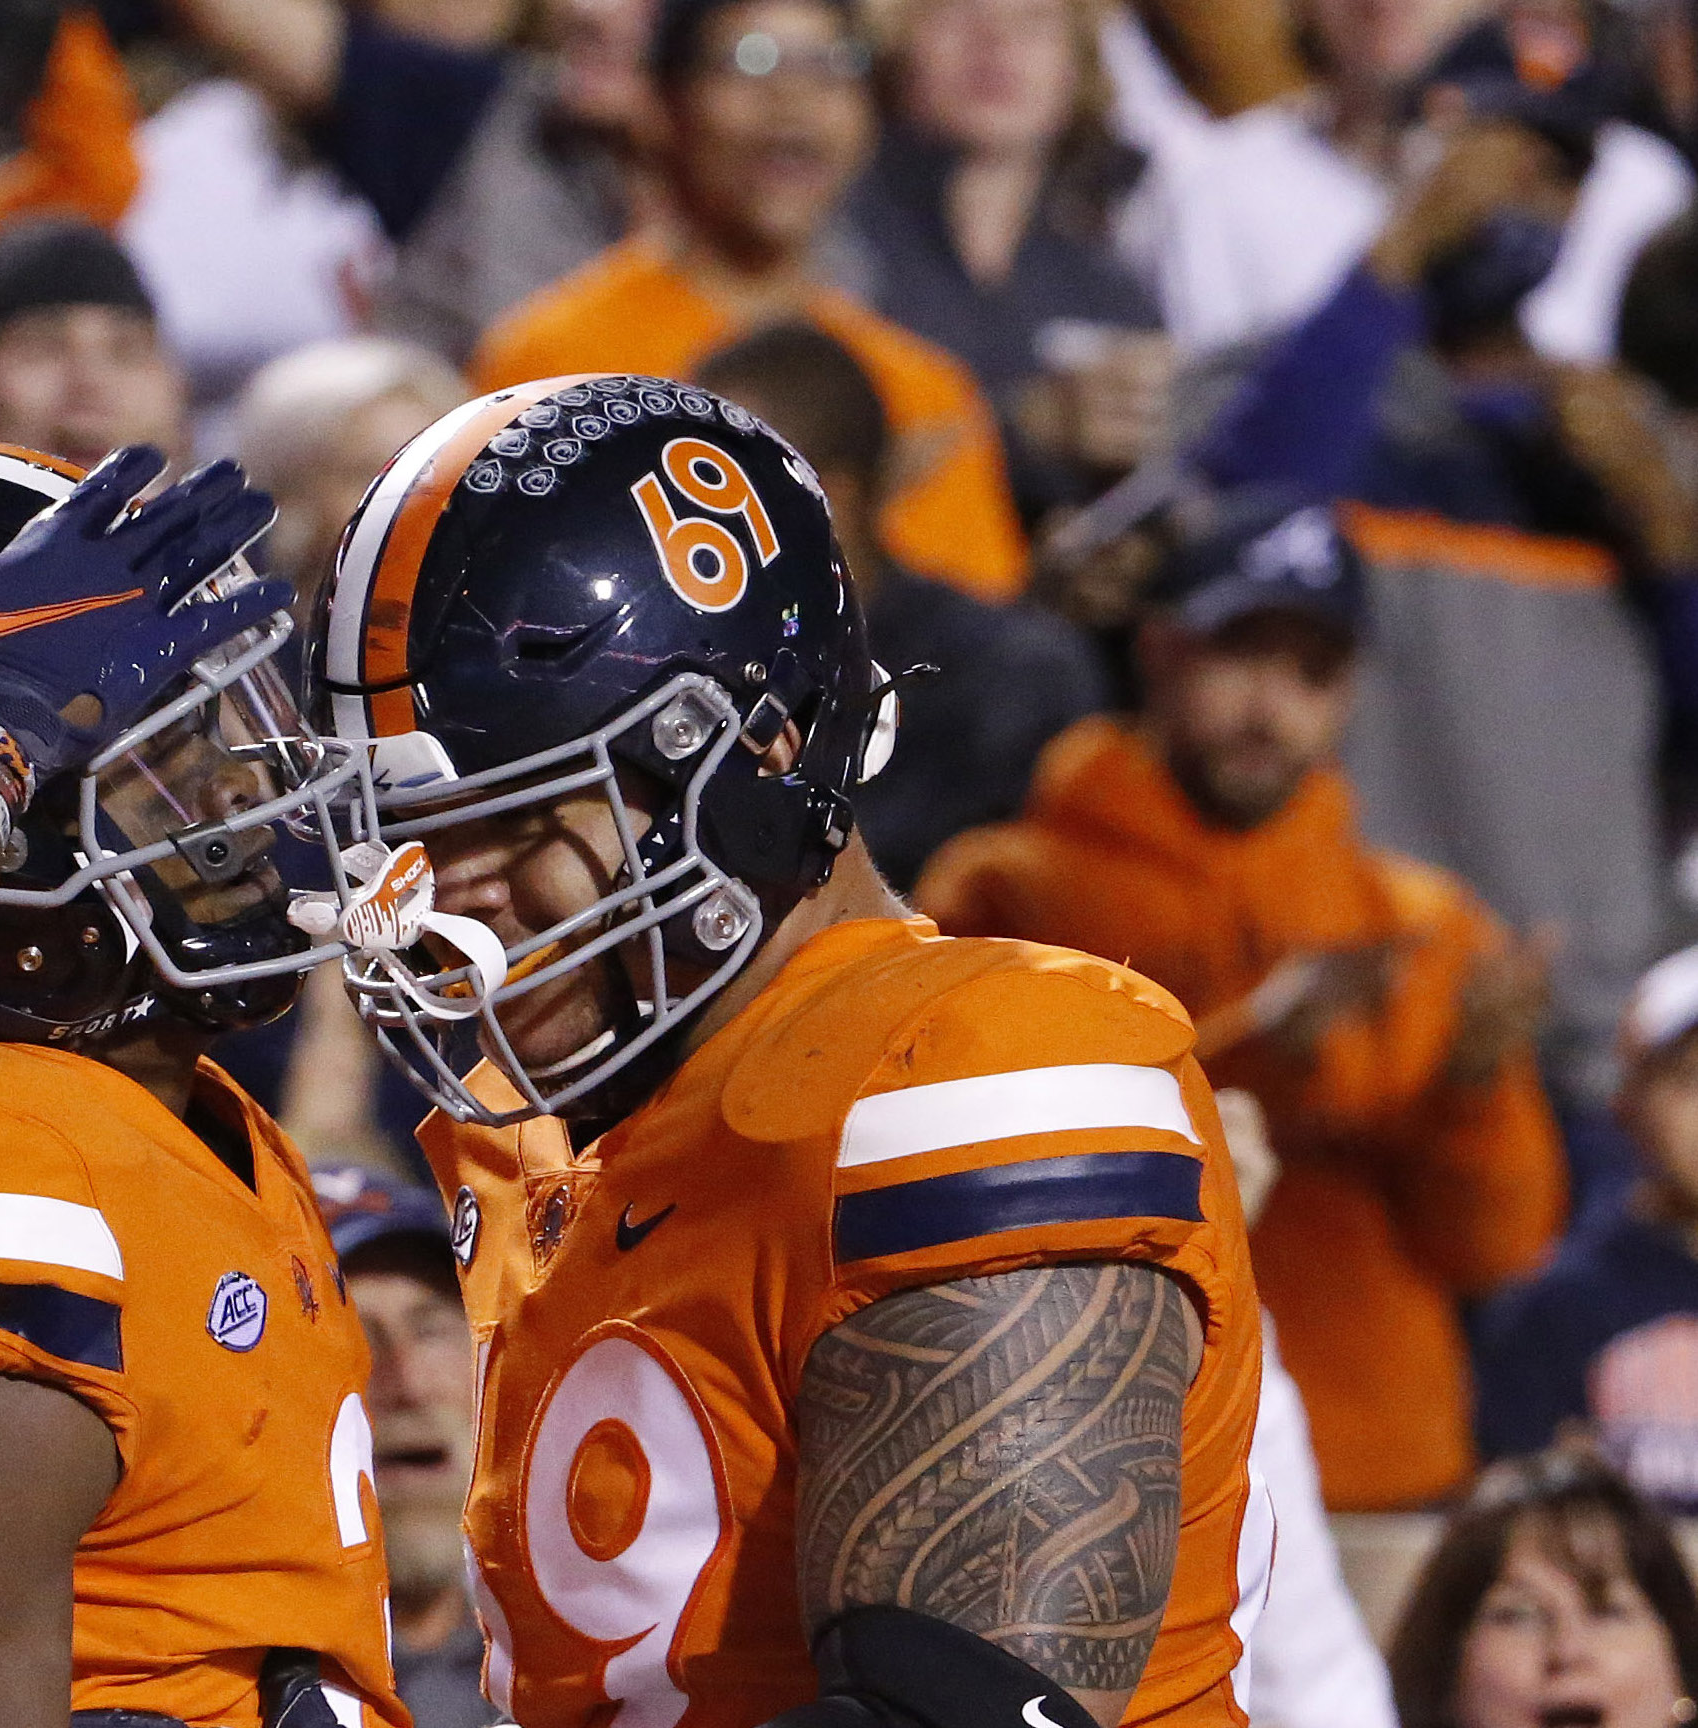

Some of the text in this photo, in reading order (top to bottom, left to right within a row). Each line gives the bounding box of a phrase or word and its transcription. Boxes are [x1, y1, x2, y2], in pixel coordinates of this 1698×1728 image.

[630, 437, 781, 613] 69
[390, 855, 426, 892] SHOCK
[220, 1284, 256, 1329] ACC
